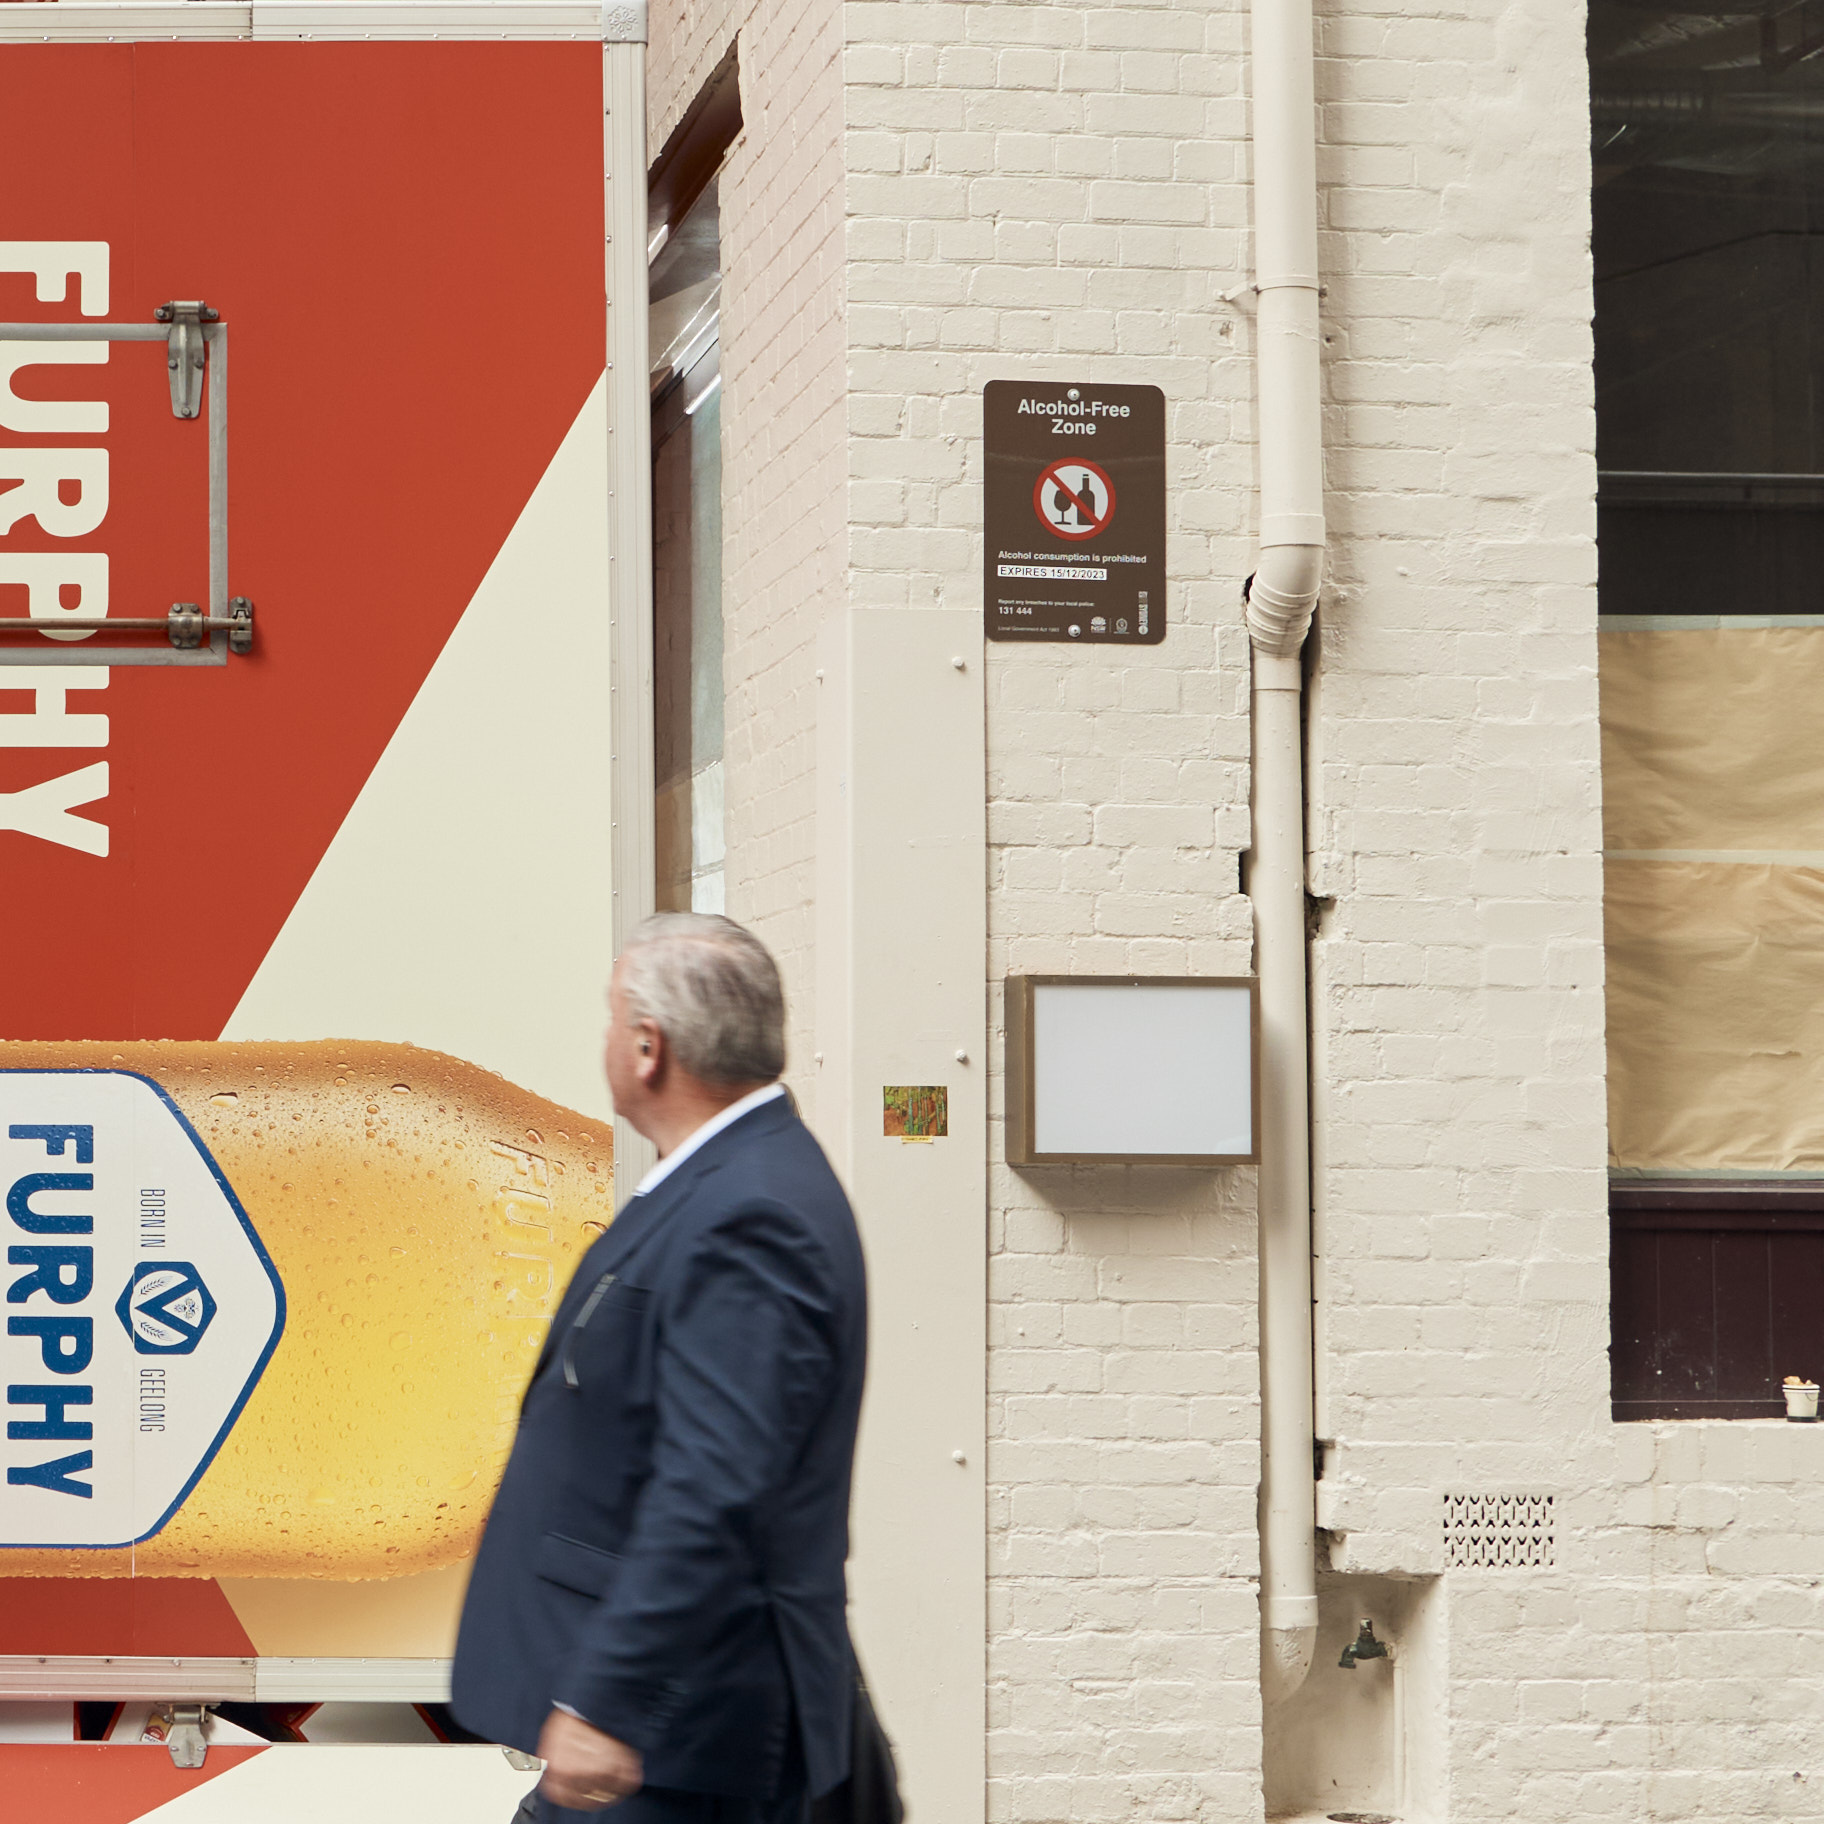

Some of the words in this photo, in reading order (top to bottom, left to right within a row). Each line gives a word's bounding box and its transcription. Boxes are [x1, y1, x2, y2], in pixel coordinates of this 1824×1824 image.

[1017, 399, 1130, 418] Alcohol-Free
[1051, 419, 1097, 435] Zone
[998, 550, 1031, 560] Alcohol
[1033, 552, 1090, 562] consumption
[1102, 554, 1147, 564] prohibited
[1000, 566, 1047, 577] EXPIRES
[1051, 568, 1104, 579] 15/12/2023
[999, 606, 1013, 614] 131
[1016, 607, 1032, 615] 444
[140, 1189, 166, 1228] BORN
[140, 1234, 166, 1249] IN
[6, 1125, 94, 1499] FURPHY
[140, 1368, 166, 1432] GEELONG
